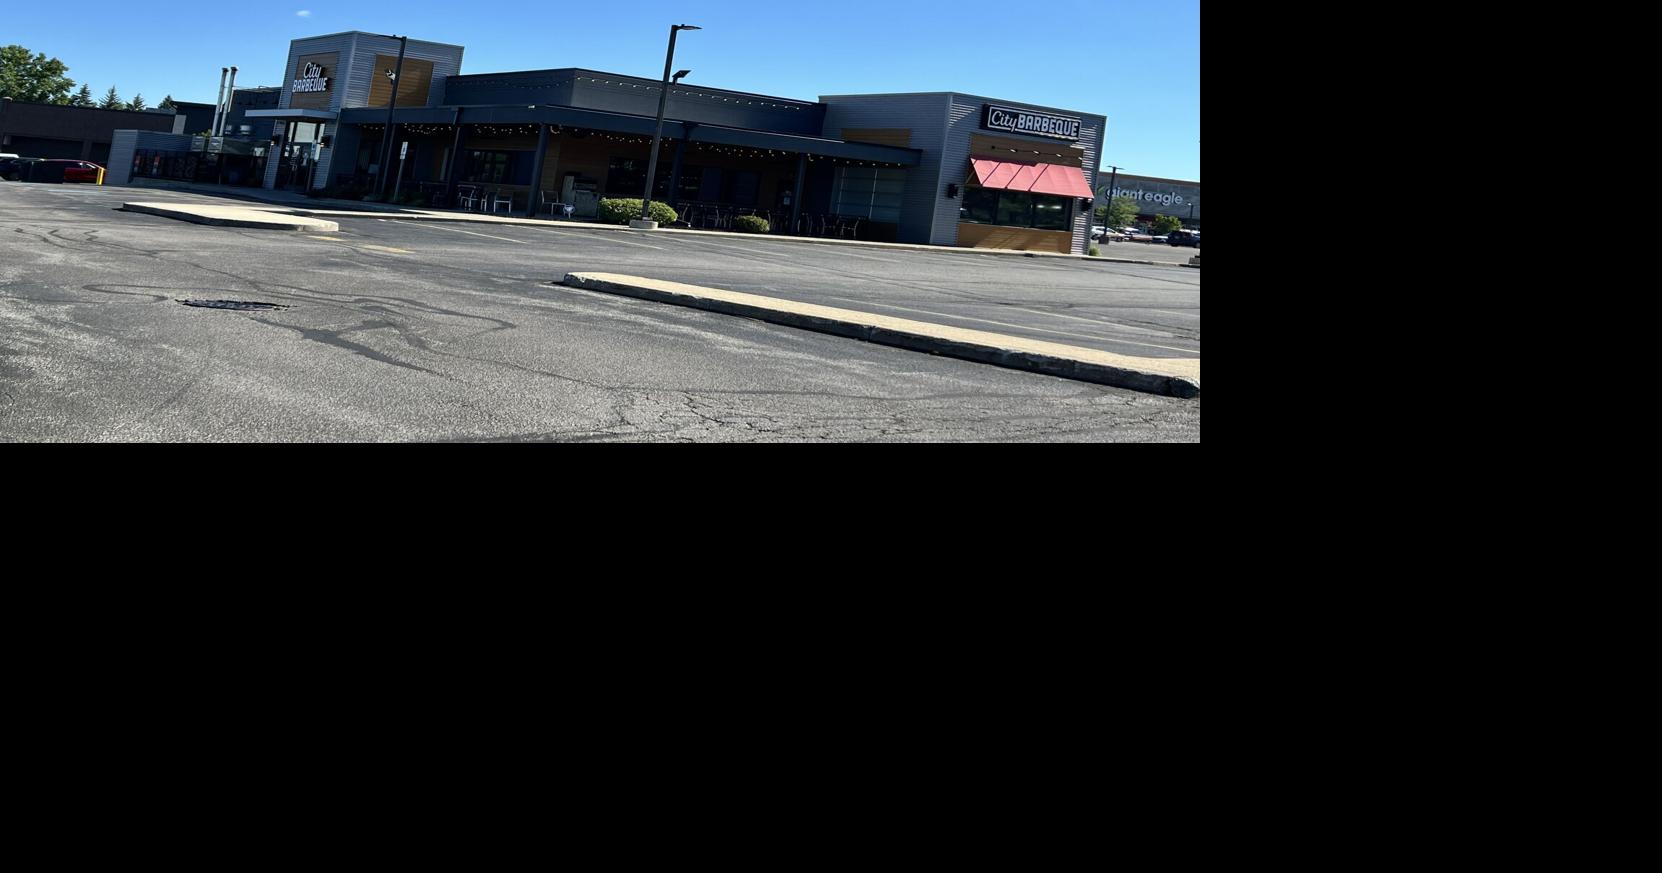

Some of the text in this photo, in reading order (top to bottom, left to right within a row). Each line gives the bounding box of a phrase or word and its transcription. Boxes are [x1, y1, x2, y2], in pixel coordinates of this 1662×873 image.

[303, 62, 322, 79] City
[292, 77, 328, 93] BARBEQUE
[991, 111, 1079, 136] City BARBEQUE
[1144, 191, 1183, 206] eagle
